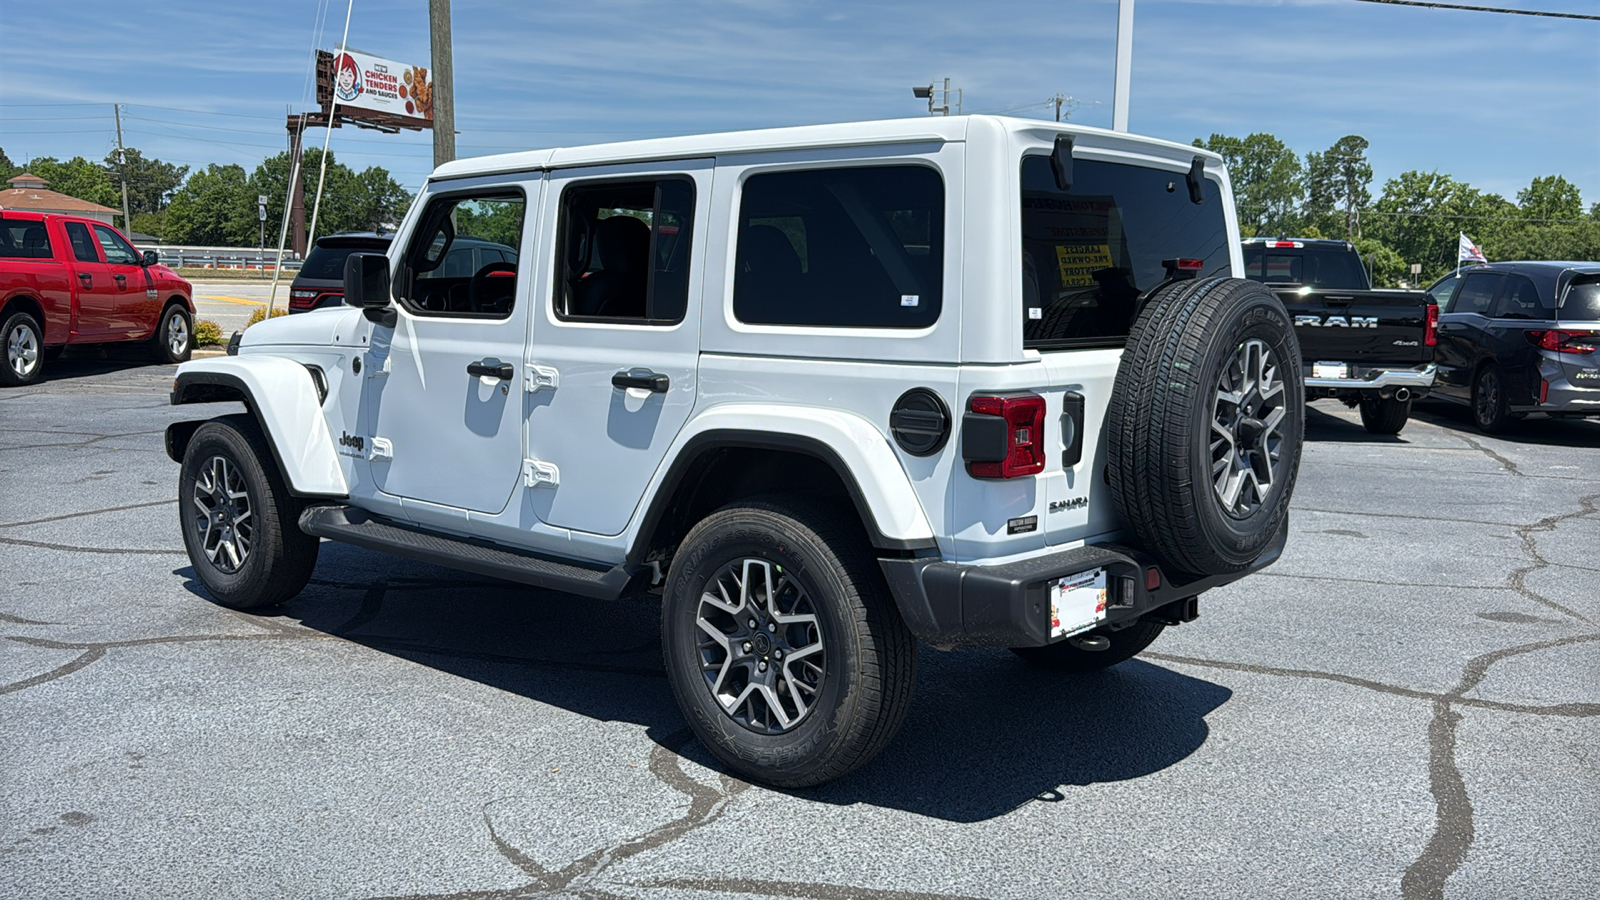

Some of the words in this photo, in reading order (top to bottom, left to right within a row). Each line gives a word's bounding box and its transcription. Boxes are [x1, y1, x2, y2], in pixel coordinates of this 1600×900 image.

[365, 70, 397, 83] CHICKEN
[365, 79, 397, 92] TENDERS
[378, 90, 398, 99] SAUCES
[1294, 315, 1378, 328] RAM
[339, 430, 364, 452] Jeep
[1049, 496, 1088, 510] SAHARA
